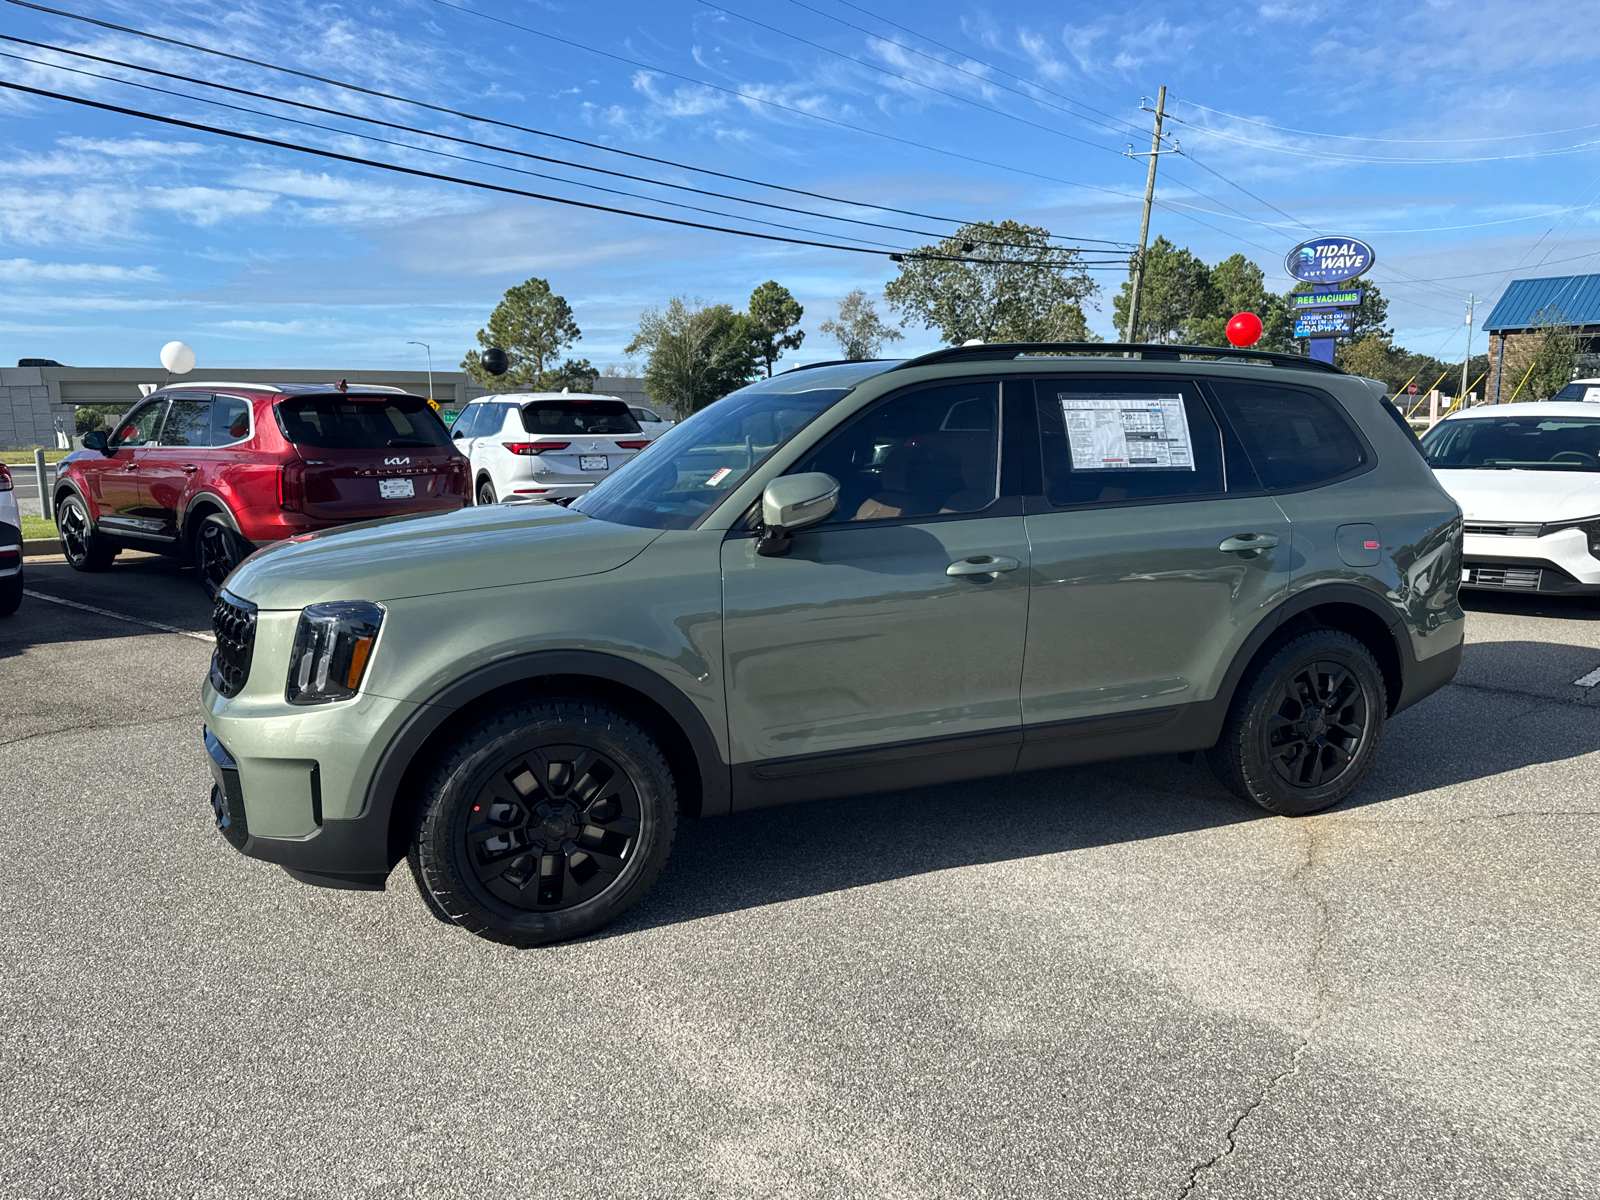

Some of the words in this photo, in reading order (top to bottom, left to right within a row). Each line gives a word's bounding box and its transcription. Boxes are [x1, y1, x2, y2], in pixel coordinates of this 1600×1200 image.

[1316, 244, 1356, 257] TIDAL
[1321, 255, 1364, 269] WAVE
[1293, 296, 1314, 304] FREE
[1316, 294, 1357, 303] VACUUMS
[384, 457, 410, 465] KIA
[354, 467, 437, 475] TELLURIDE
